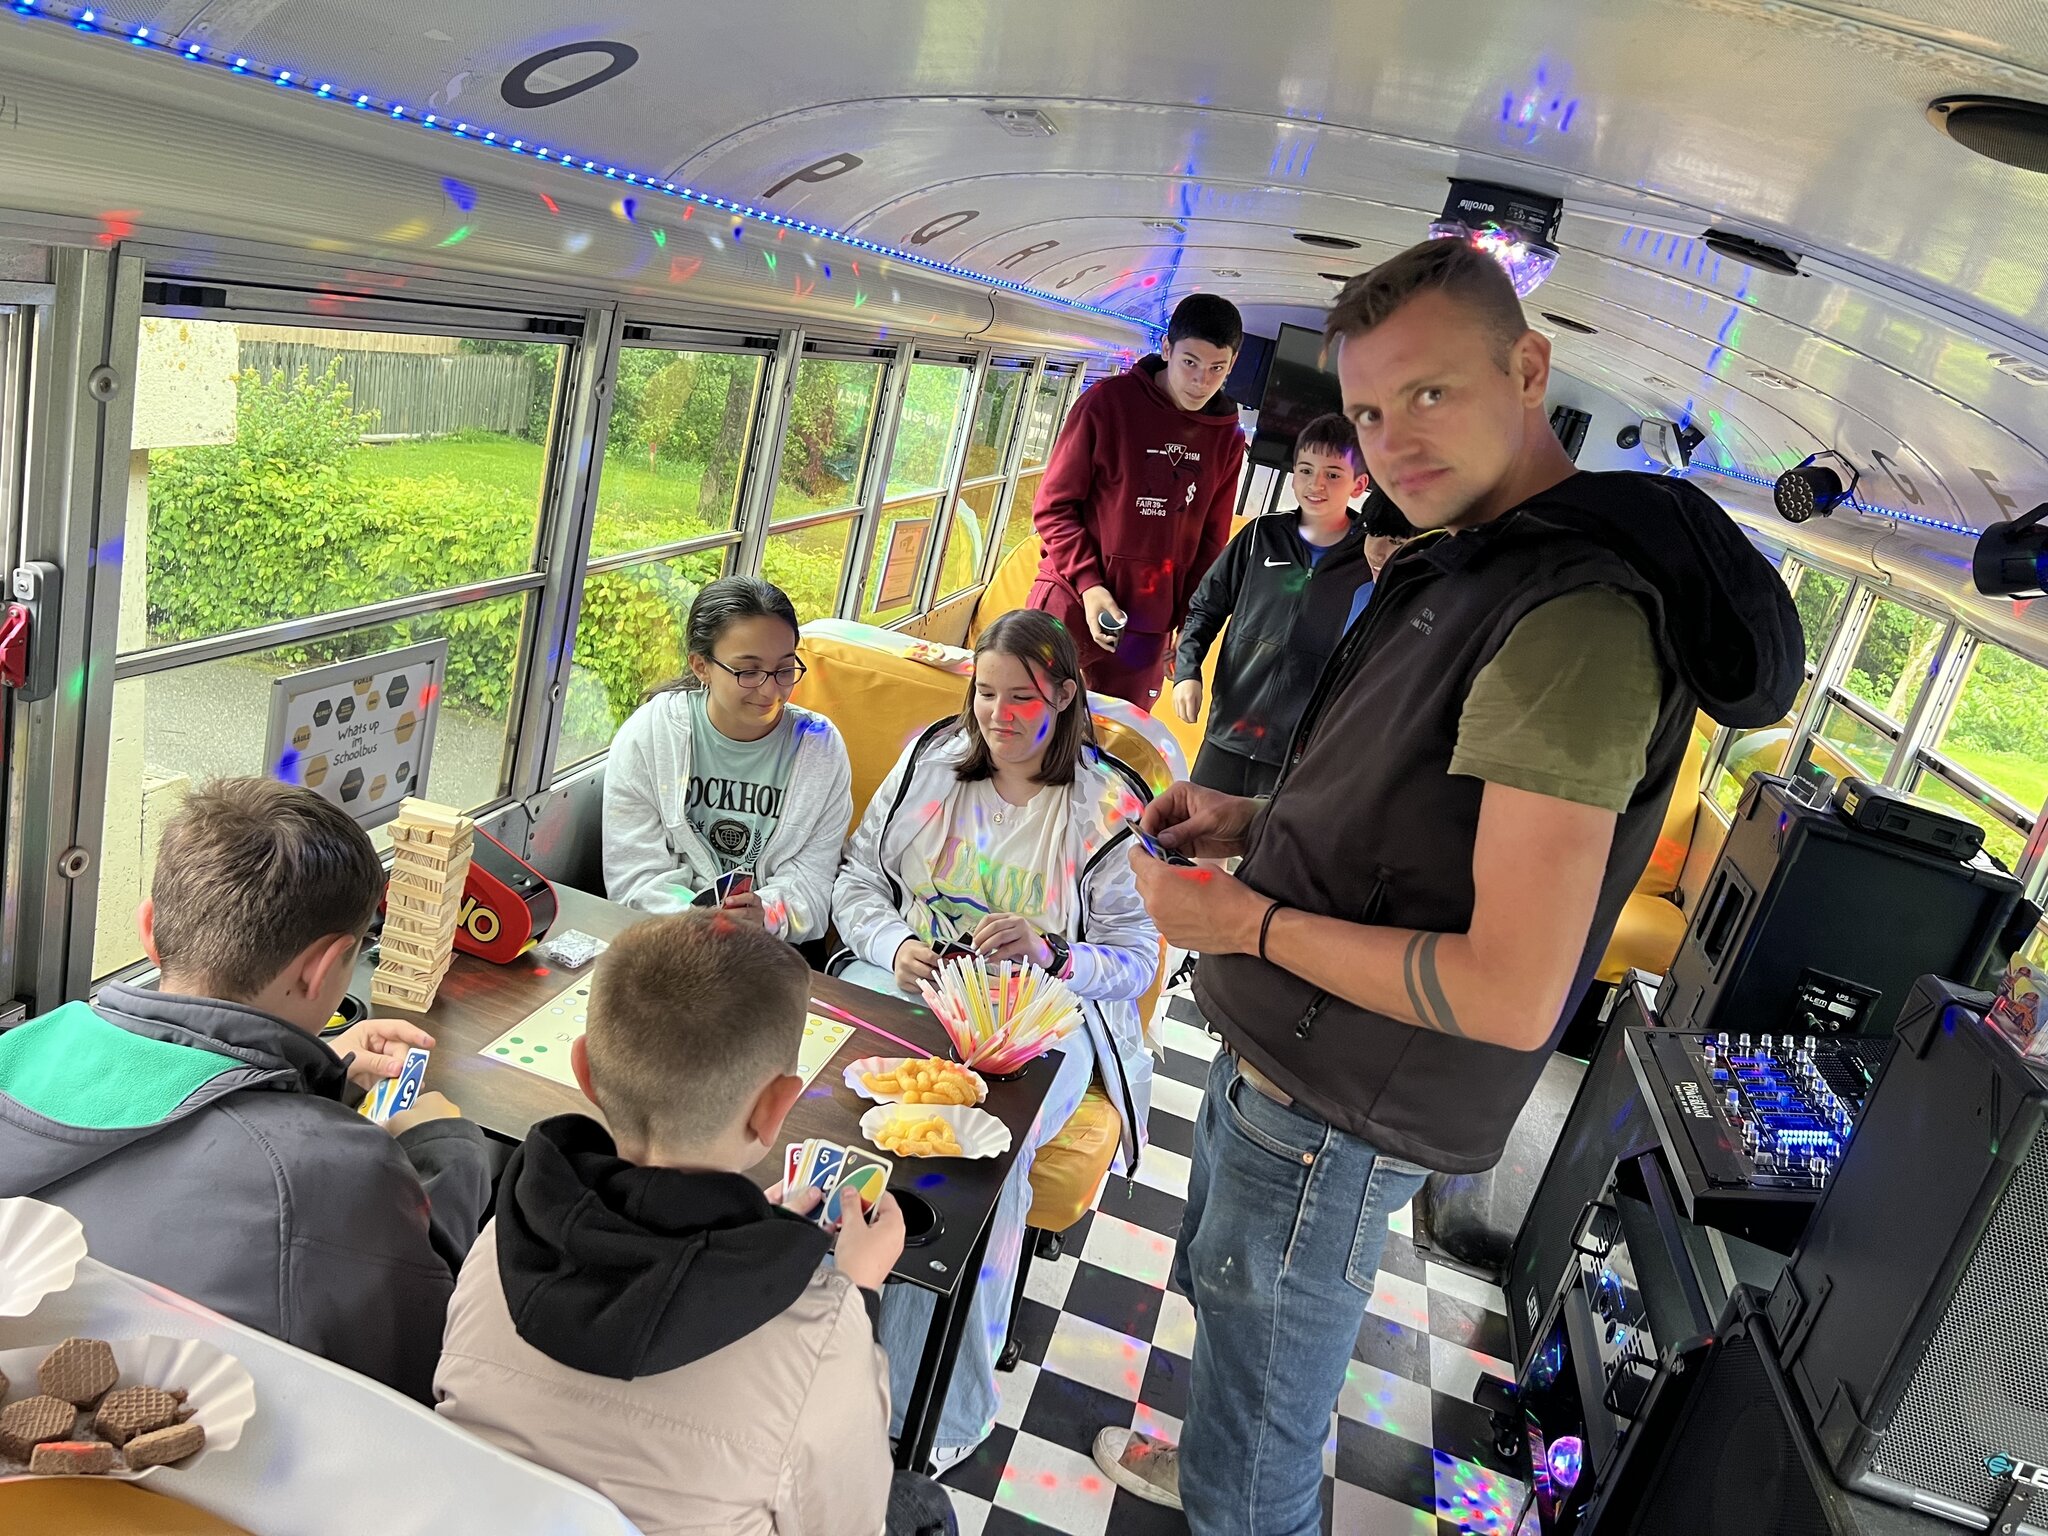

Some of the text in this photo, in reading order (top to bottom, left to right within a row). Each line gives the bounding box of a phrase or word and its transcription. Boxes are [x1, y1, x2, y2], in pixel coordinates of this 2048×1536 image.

[501, 40, 1106, 289] O P Q R S
[1168, 445, 1184, 455] KPL
[1871, 449, 1926, 506] G
[369, 721, 380, 735] up
[333, 743, 378, 766] Schoolbus
[352, 737, 363, 749] im
[685, 776, 784, 820] OCKHOL
[820, 1149, 830, 1164] 5
[2011, 1461, 2048, 1490] LE
